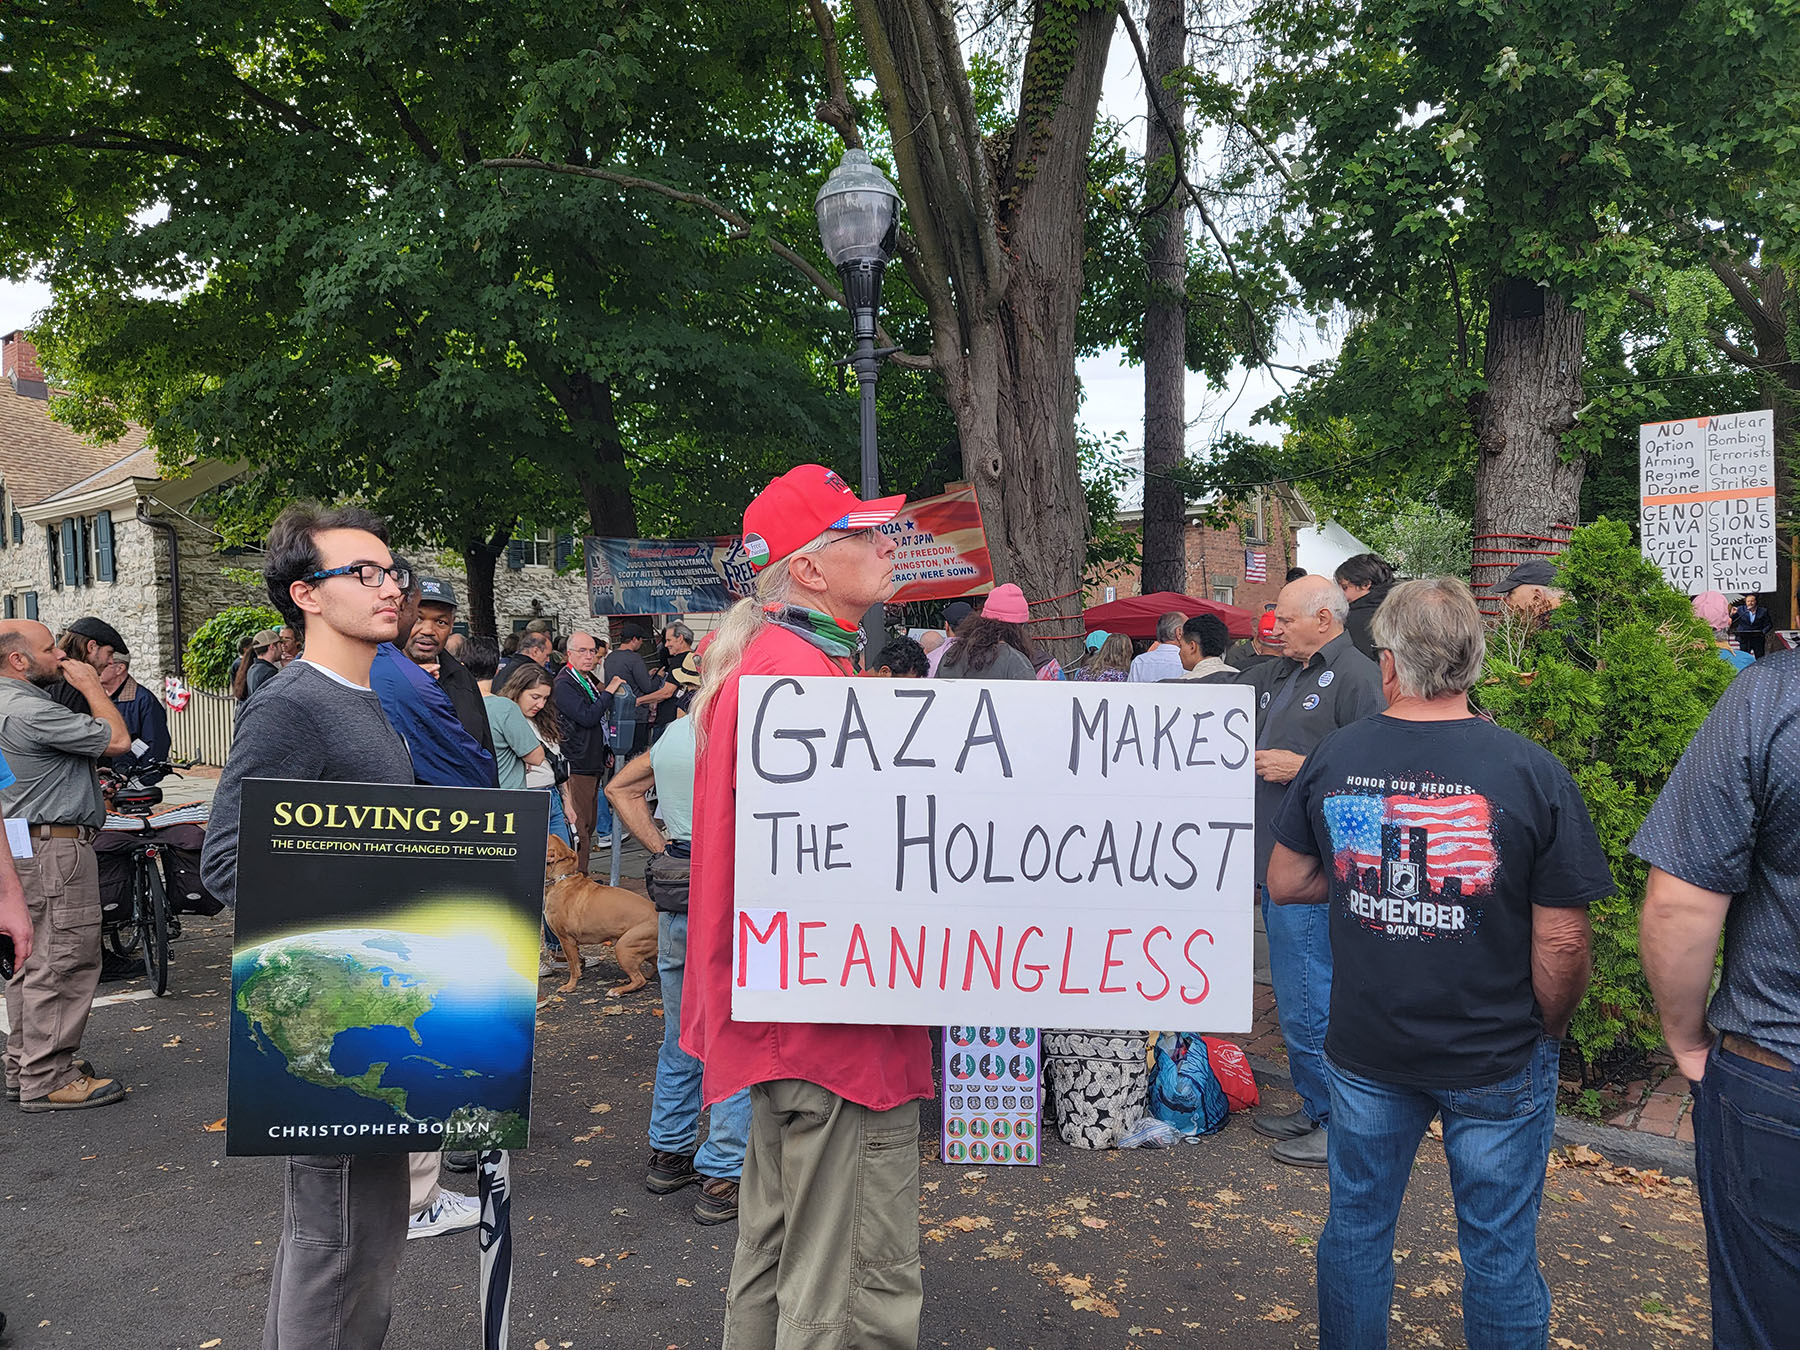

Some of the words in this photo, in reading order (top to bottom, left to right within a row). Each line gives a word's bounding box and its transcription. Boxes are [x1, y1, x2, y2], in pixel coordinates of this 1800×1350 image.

[1657, 422, 1685, 438] NO
[1707, 416, 1767, 433] Nuclear
[1645, 440, 1694, 457] Option
[1708, 431, 1766, 447] Bombing
[1644, 454, 1695, 469] Arming
[1708, 448, 1771, 462] Terrorists
[1645, 469, 1700, 486] Regime
[1709, 463, 1769, 478] Change
[1648, 483, 1700, 496] Drone
[1711, 476, 1768, 491] Strikes
[881, 522, 902, 535] 024
[901, 536, 913, 547] AT
[914, 533, 935, 546] 3PM
[1710, 531, 1774, 546] Sanctions
[897, 549, 908, 559] OF
[911, 546, 955, 558] FREEDOM:
[618, 570, 640, 579] SCOTT
[720, 559, 758, 593] FREE
[891, 572, 918, 582] CRACY
[919, 569, 945, 579] WERE
[1661, 565, 1704, 579] EVER
[1713, 561, 1768, 577] Solved
[650, 589, 664, 597] AND
[665, 587, 692, 596] OTHERS
[1714, 577, 1762, 592] Thing
[750, 677, 1013, 785] GAZA
[1067, 696, 1250, 779] MAKES
[1347, 775, 1385, 789] HONOR
[1391, 780, 1416, 791] OUR
[273, 801, 441, 832] SOLVING
[449, 810, 516, 834] 9-11
[271, 839, 294, 849] THE
[296, 840, 361, 851] DECEPTION
[363, 842, 392, 852] THAT
[395, 844, 450, 855] CHANGED
[452, 846, 474, 855] THE
[476, 846, 517, 857] WORLD
[753, 811, 851, 876] THE
[895, 794, 1254, 895] HOLOCAUST
[1350, 889, 1465, 930] REMEMBER
[1386, 924, 1419, 937] 9/11/01
[736, 910, 1214, 1006] MEANINGLESS
[268, 1123, 409, 1138] CHRISTOPHER
[418, 1122, 490, 1134] BOLLYN
